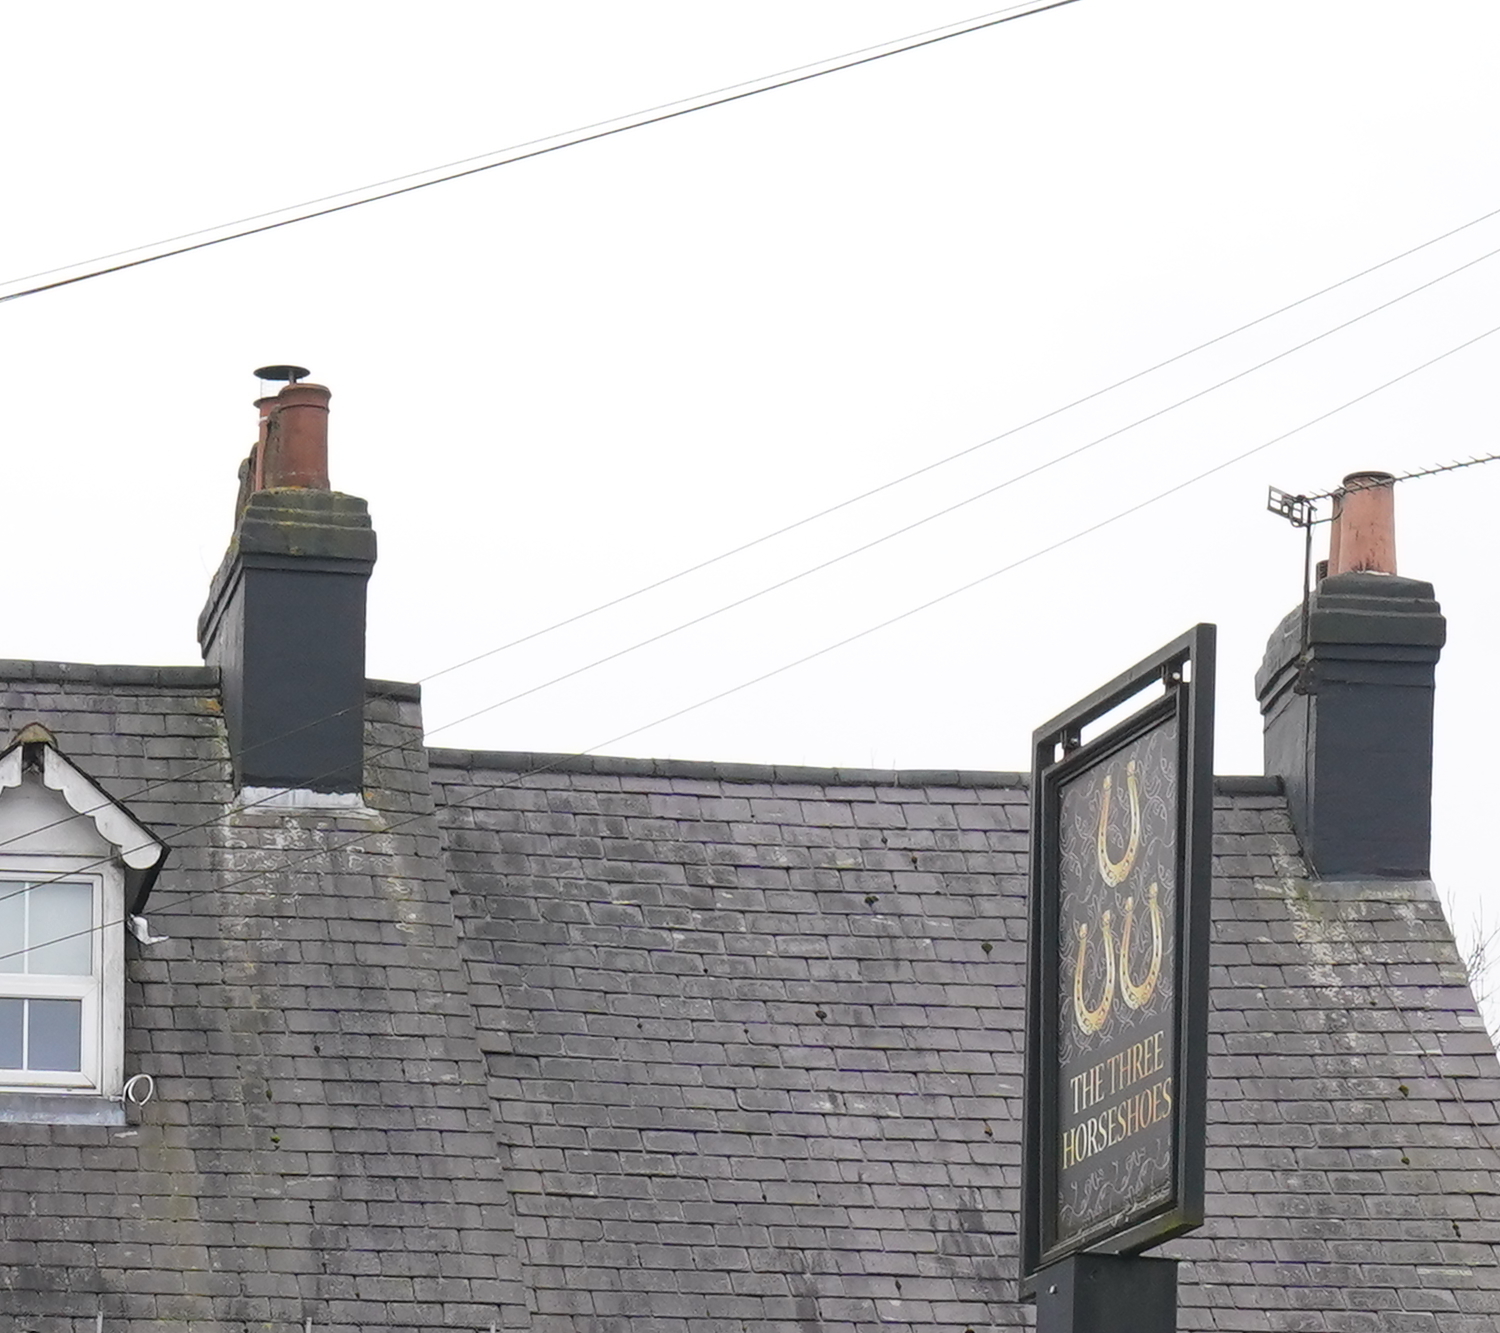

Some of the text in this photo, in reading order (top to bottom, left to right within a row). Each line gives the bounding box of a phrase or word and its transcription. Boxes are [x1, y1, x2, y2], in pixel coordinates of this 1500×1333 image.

[1070, 1030, 1165, 1115] THE THREE
[1062, 1076, 1173, 1171] HORSESHOES
